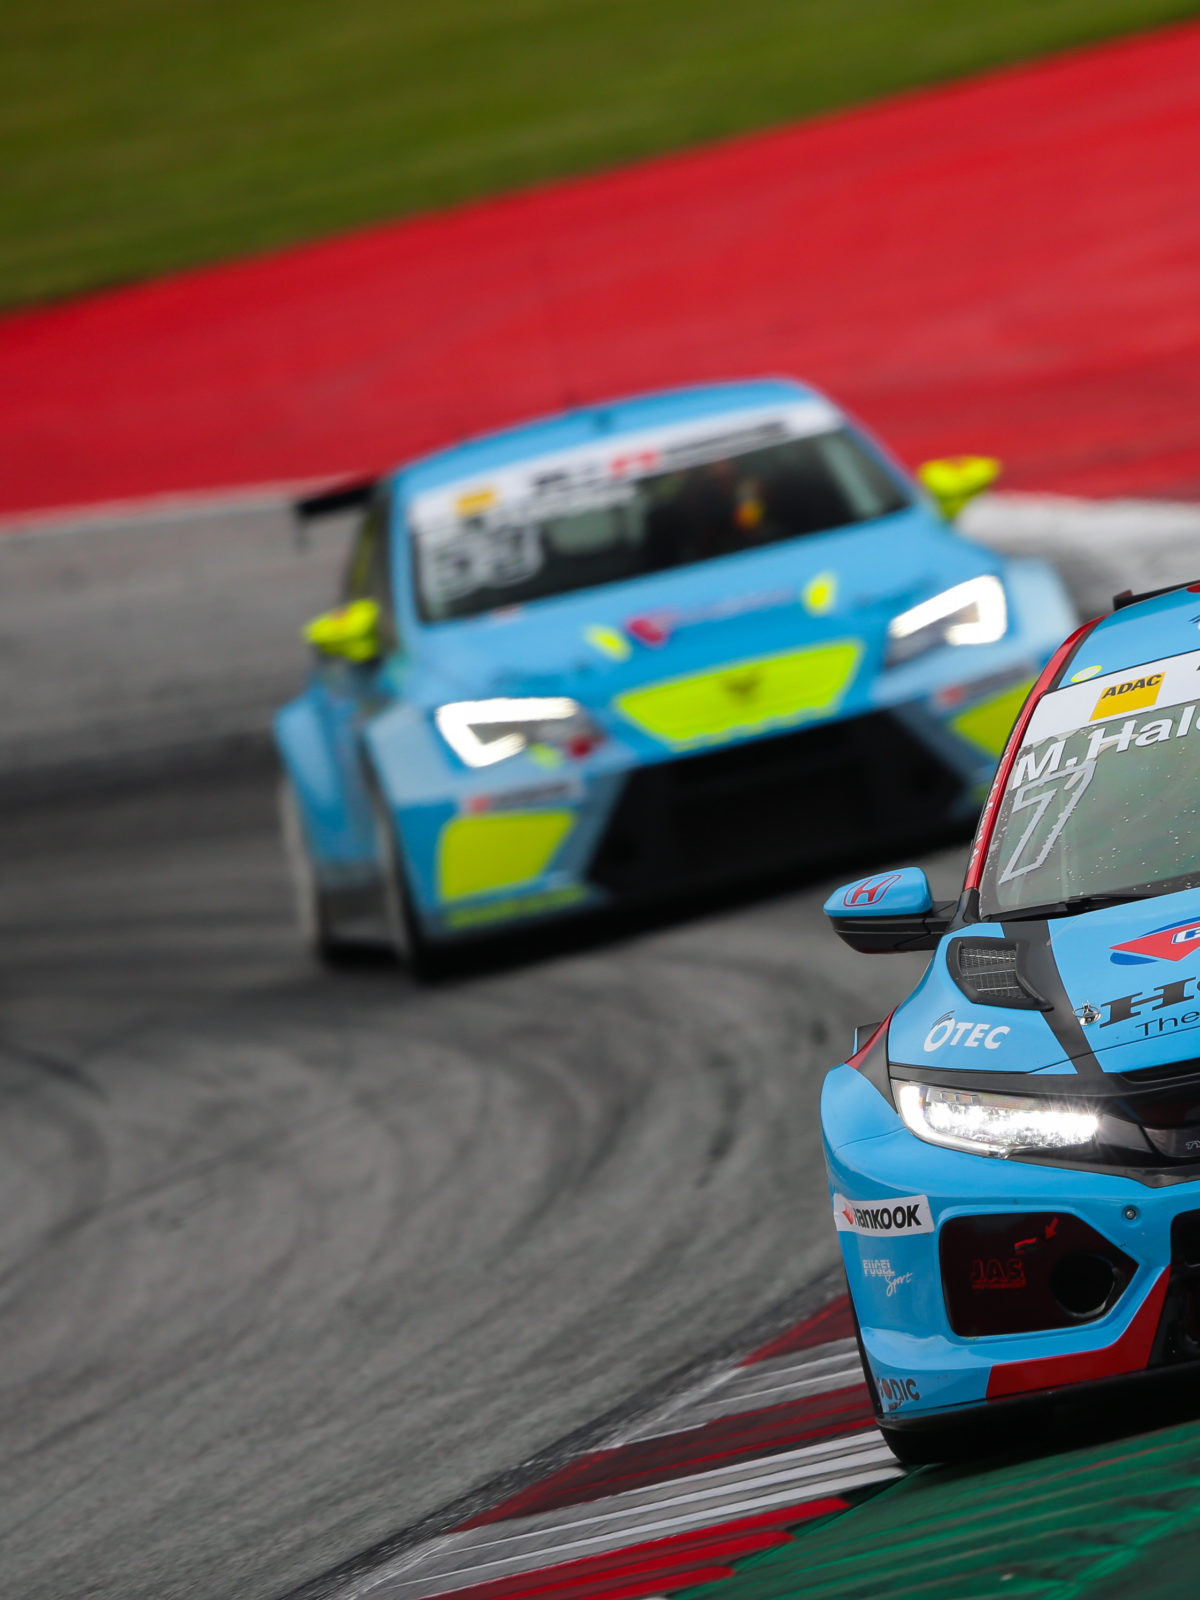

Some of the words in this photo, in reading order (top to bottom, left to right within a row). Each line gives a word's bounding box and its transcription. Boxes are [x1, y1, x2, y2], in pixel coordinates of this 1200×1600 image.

[1102, 673, 1162, 699] ADAC
[999, 760, 1097, 884] 7
[923, 1017, 1011, 1053] OTEC
[1135, 1010, 1200, 1038] The
[970, 1257, 1026, 1284] JAS
